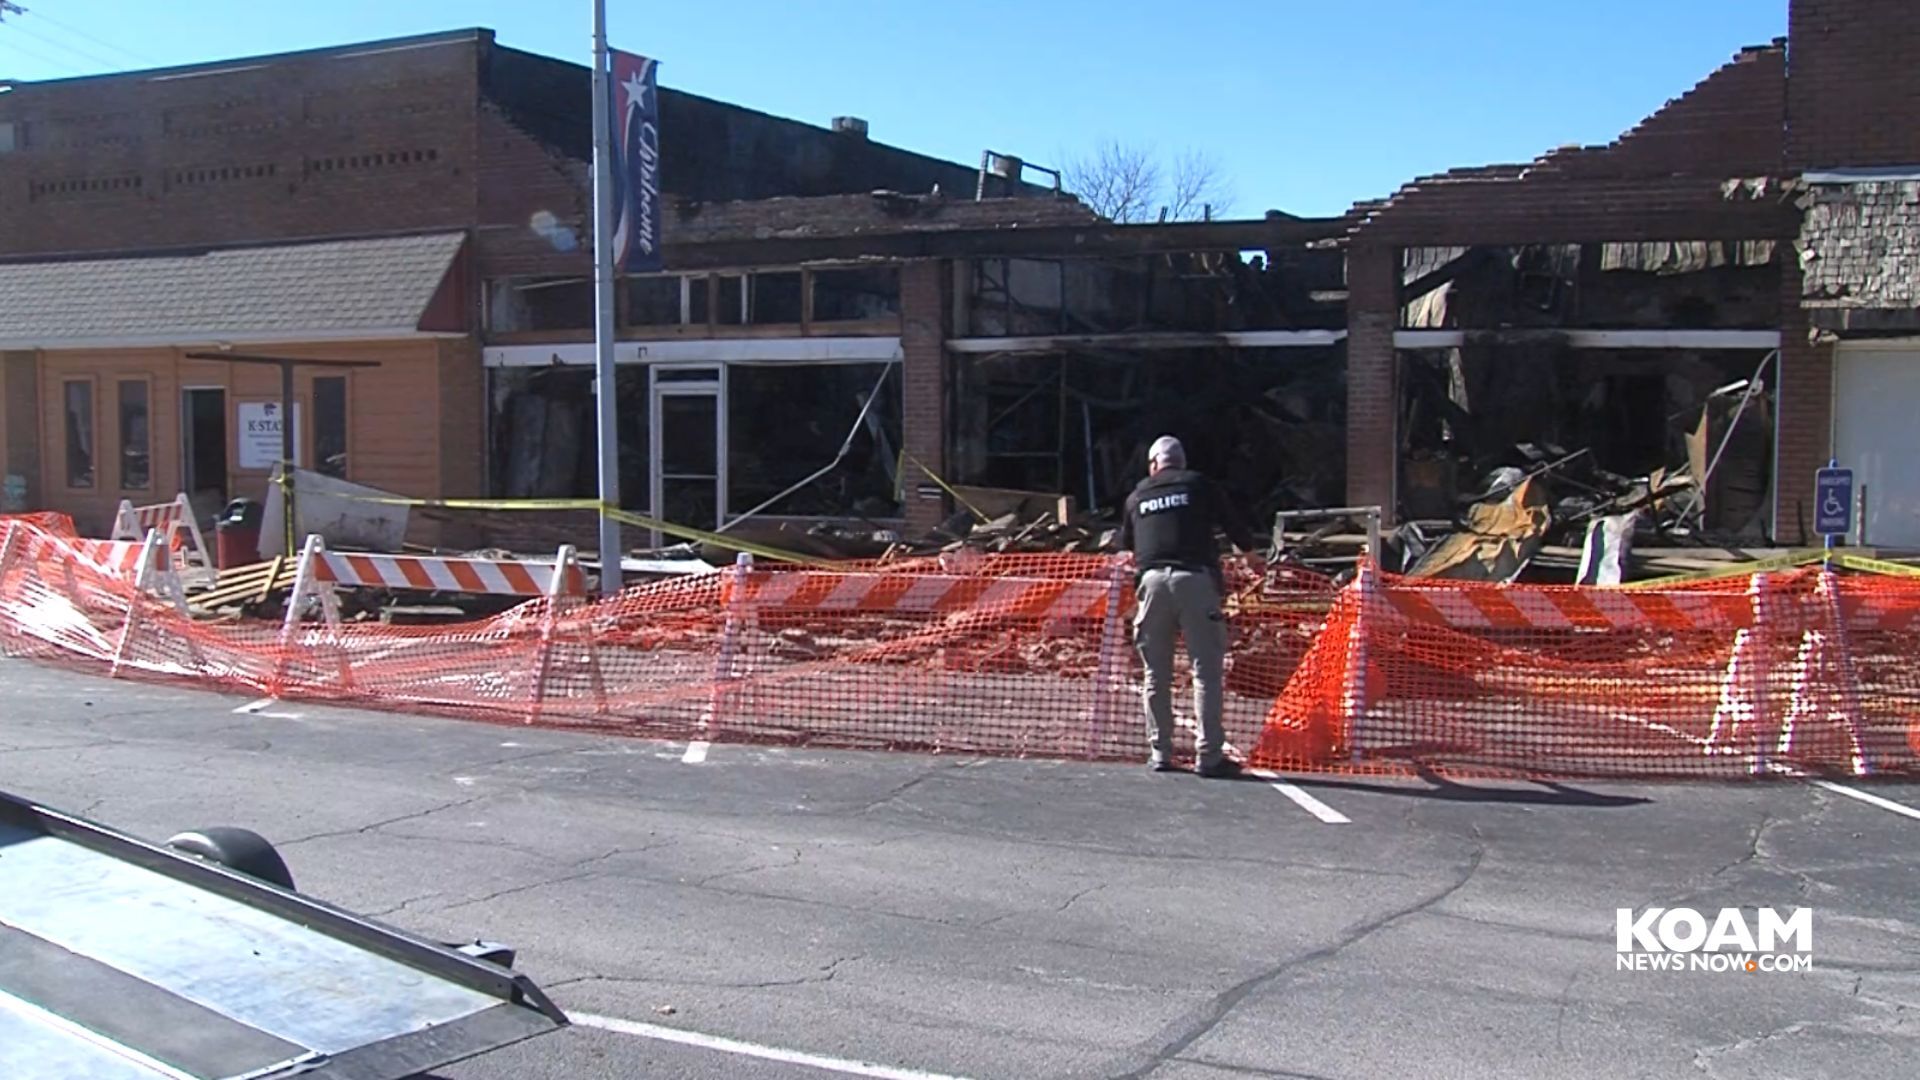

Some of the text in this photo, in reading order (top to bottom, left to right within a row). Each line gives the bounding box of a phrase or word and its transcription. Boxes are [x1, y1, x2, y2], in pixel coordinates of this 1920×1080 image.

[639, 121, 658, 255] Welcome
[248, 419, 283, 432] K-STA
[1140, 493, 1189, 515] POLICE
